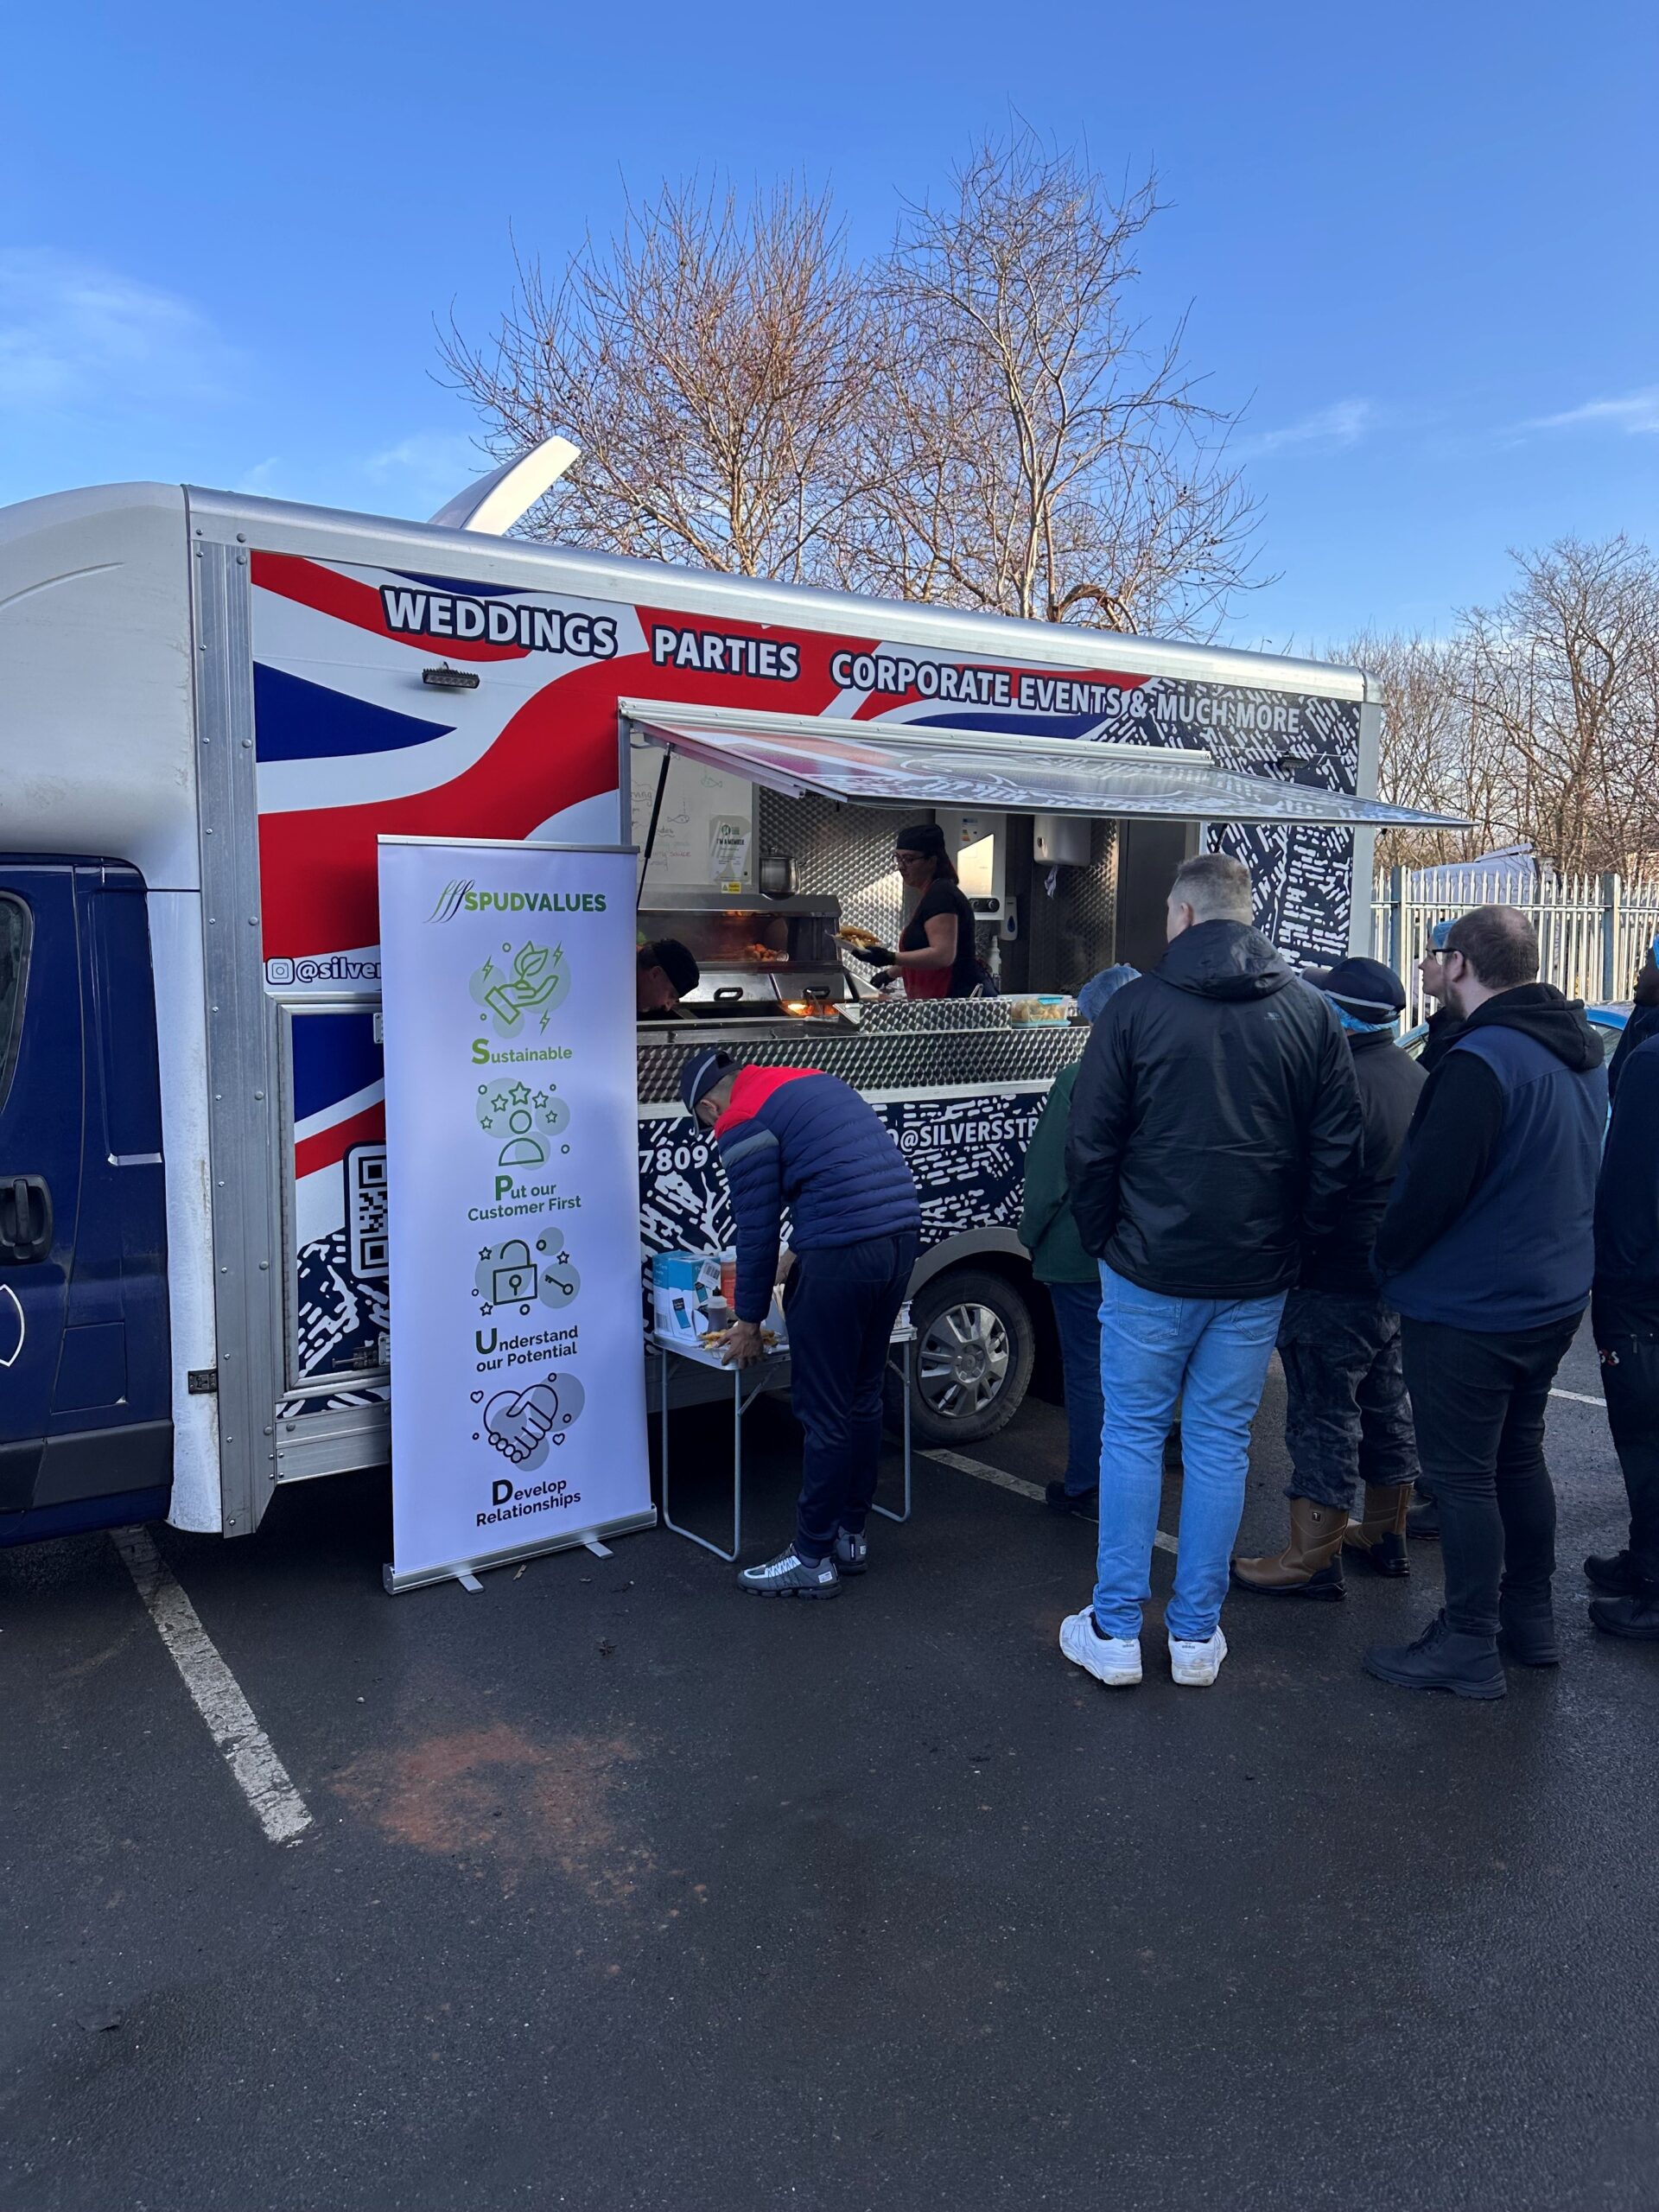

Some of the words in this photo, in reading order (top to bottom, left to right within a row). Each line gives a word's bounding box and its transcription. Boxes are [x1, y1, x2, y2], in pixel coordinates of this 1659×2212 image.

[382, 588, 620, 657] WEDDINGS
[653, 626, 799, 680] PARTIES
[830, 652, 1011, 707] CORPORATE
[1020, 676, 1122, 718] EVENTS
[1129, 690, 1148, 718] &
[1156, 693, 1228, 727] MUCH
[1236, 703, 1300, 734] MORE
[464, 892, 607, 912] SPUDVALUES
[471, 1038, 573, 1065] Sustainable
[495, 1174, 527, 1201] Put
[531, 1184, 556, 1197] our
[467, 1201, 545, 1222] Customer
[549, 1195, 582, 1211] First
[475, 1325, 579, 1355] Understand
[476, 1357, 504, 1372] our
[507, 1341, 577, 1367] Potential
[492, 1478, 567, 1506] Develop
[476, 1492, 582, 1527] Relationships
